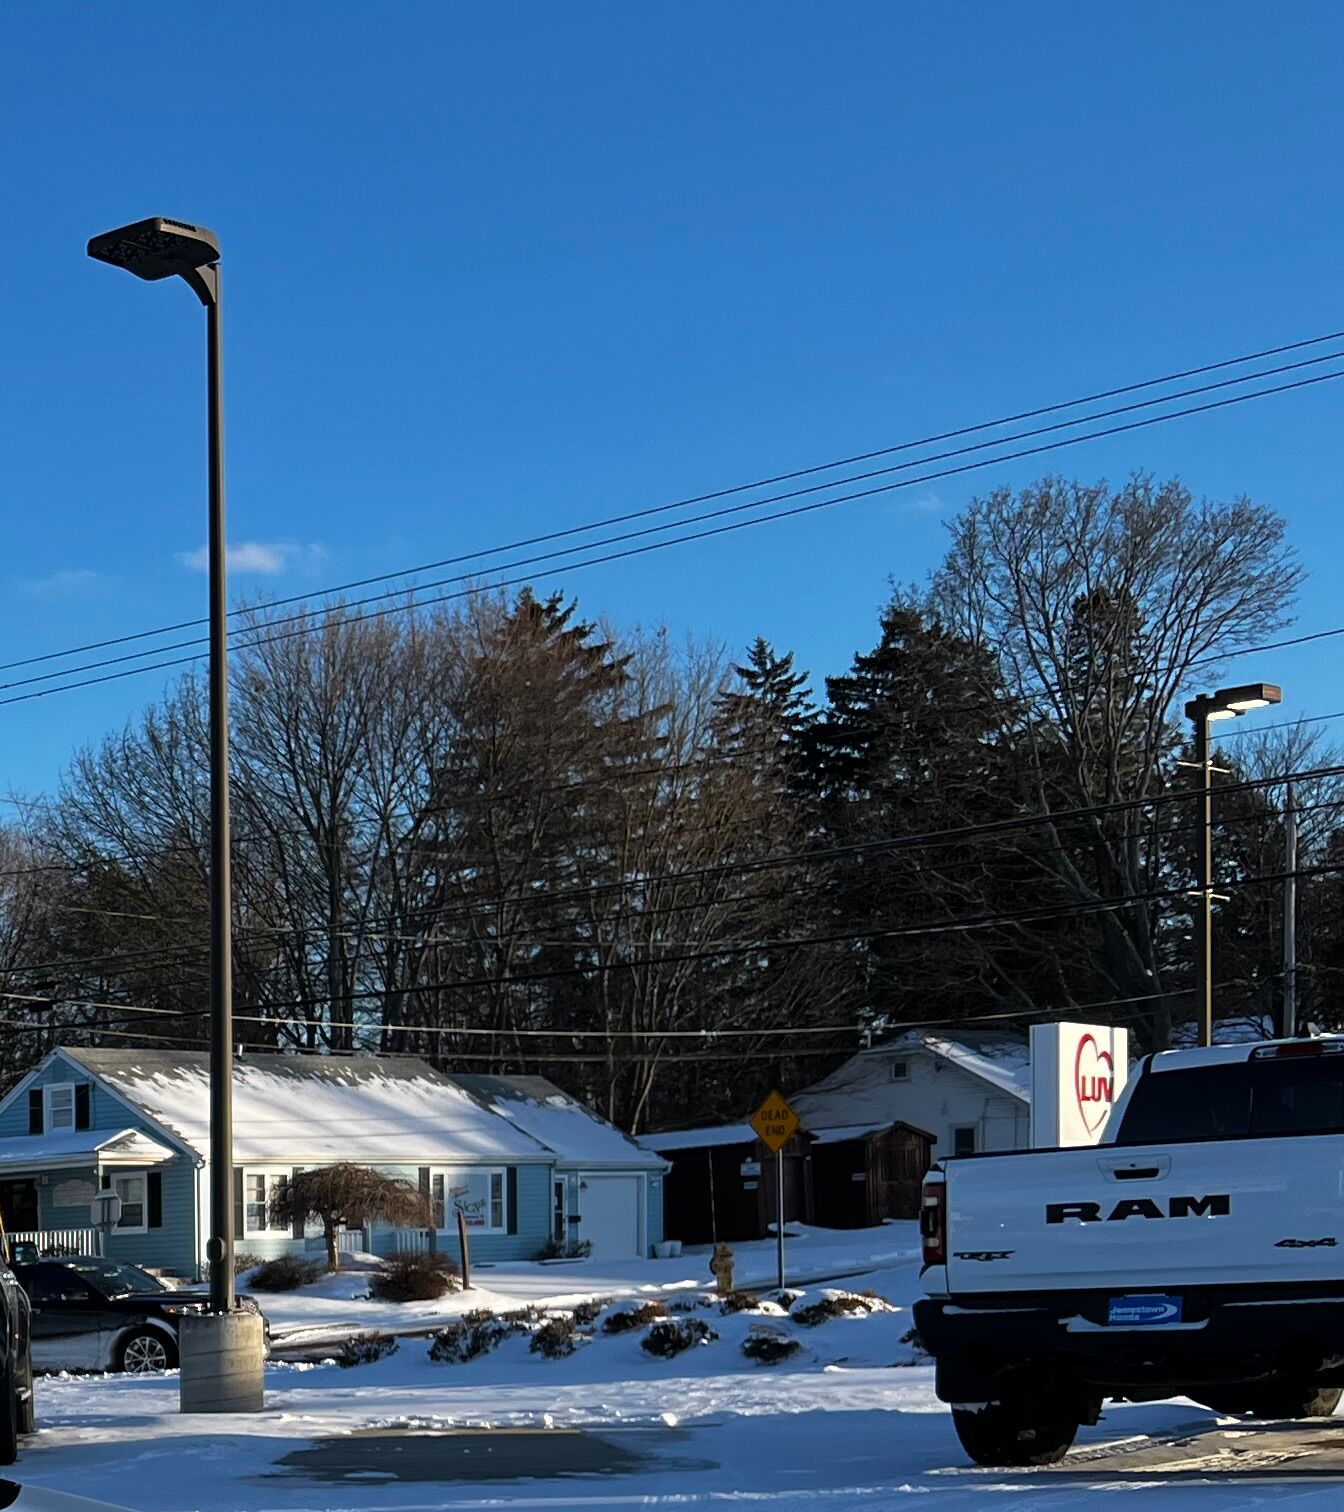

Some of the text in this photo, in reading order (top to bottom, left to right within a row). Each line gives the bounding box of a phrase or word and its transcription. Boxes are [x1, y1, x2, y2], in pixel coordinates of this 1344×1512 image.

[761, 1110, 788, 1121] DEAD
[765, 1125, 785, 1136] END
[1046, 1194, 1230, 1225] RAM
[1274, 1237, 1340, 1248] 4x4
